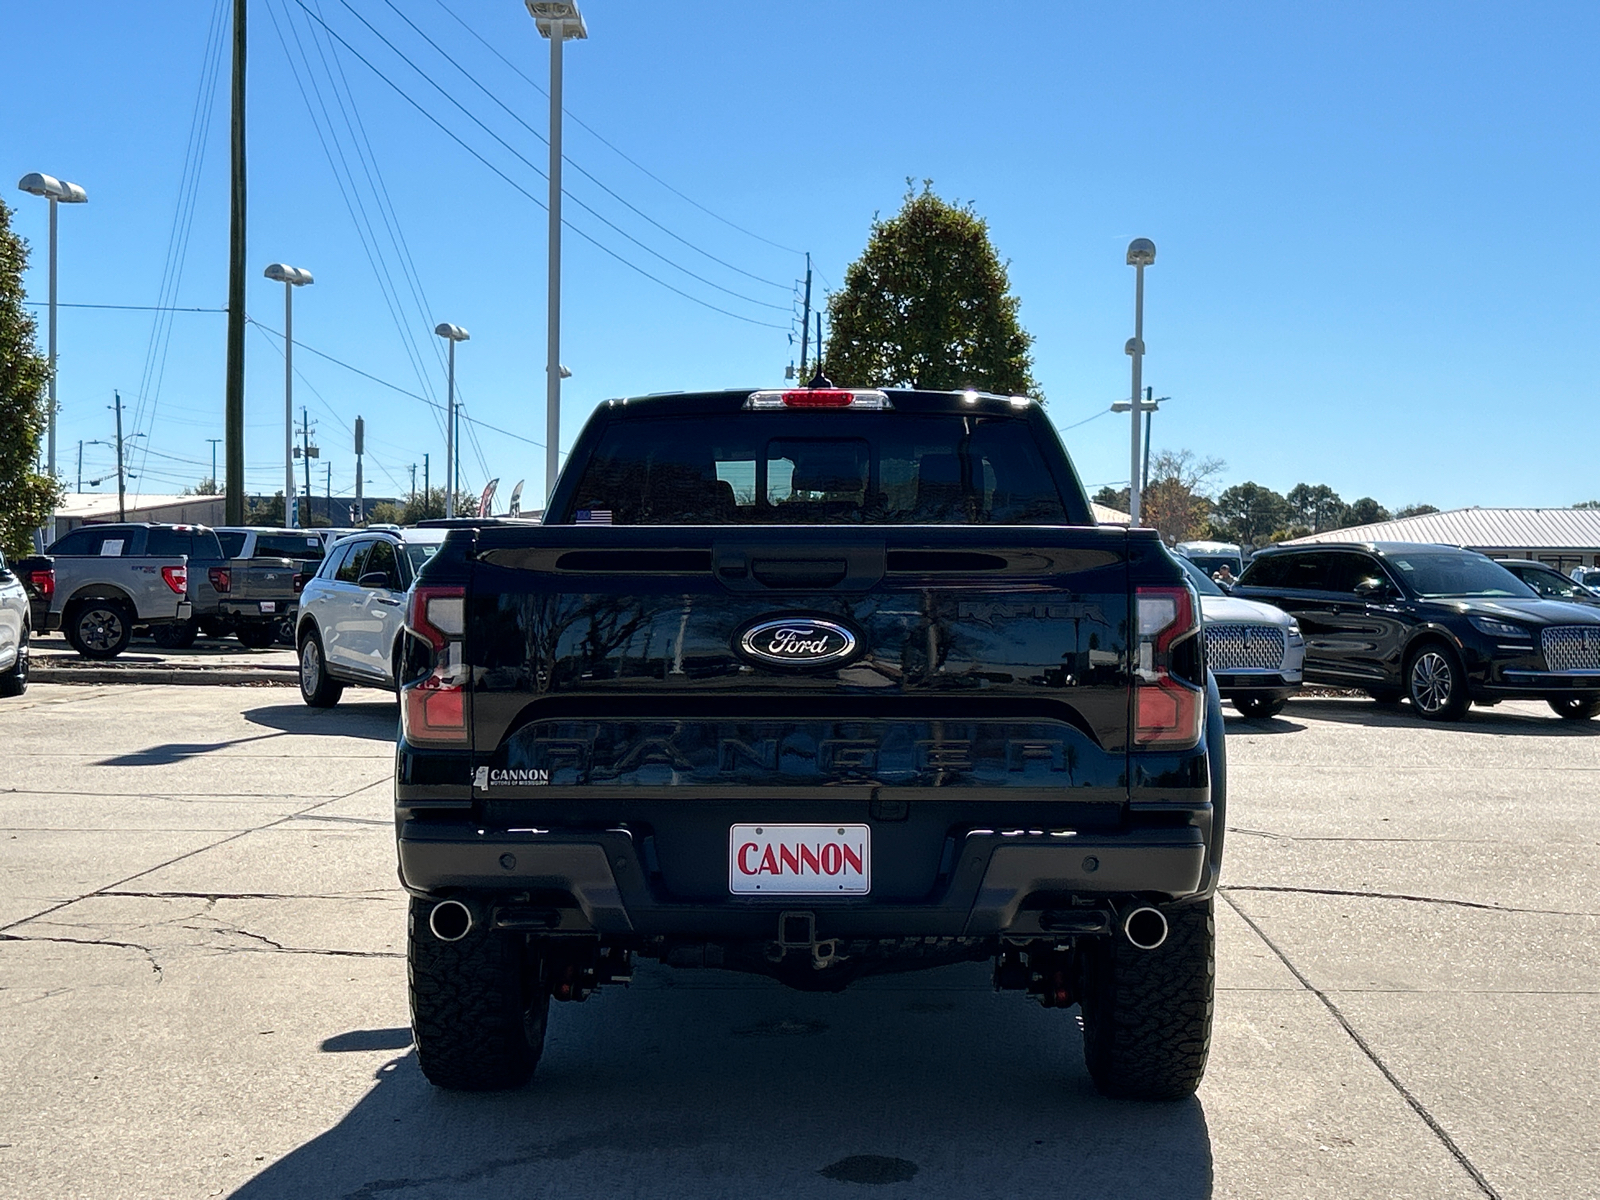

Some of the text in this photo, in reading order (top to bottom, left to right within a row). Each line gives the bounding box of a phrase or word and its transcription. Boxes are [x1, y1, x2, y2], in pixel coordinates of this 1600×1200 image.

[959, 601, 1111, 627] RAPTOR
[768, 628, 829, 654] Ford
[534, 738, 1067, 773] RANGER
[490, 769, 549, 780] CANNON
[737, 842, 863, 876] CANNON
